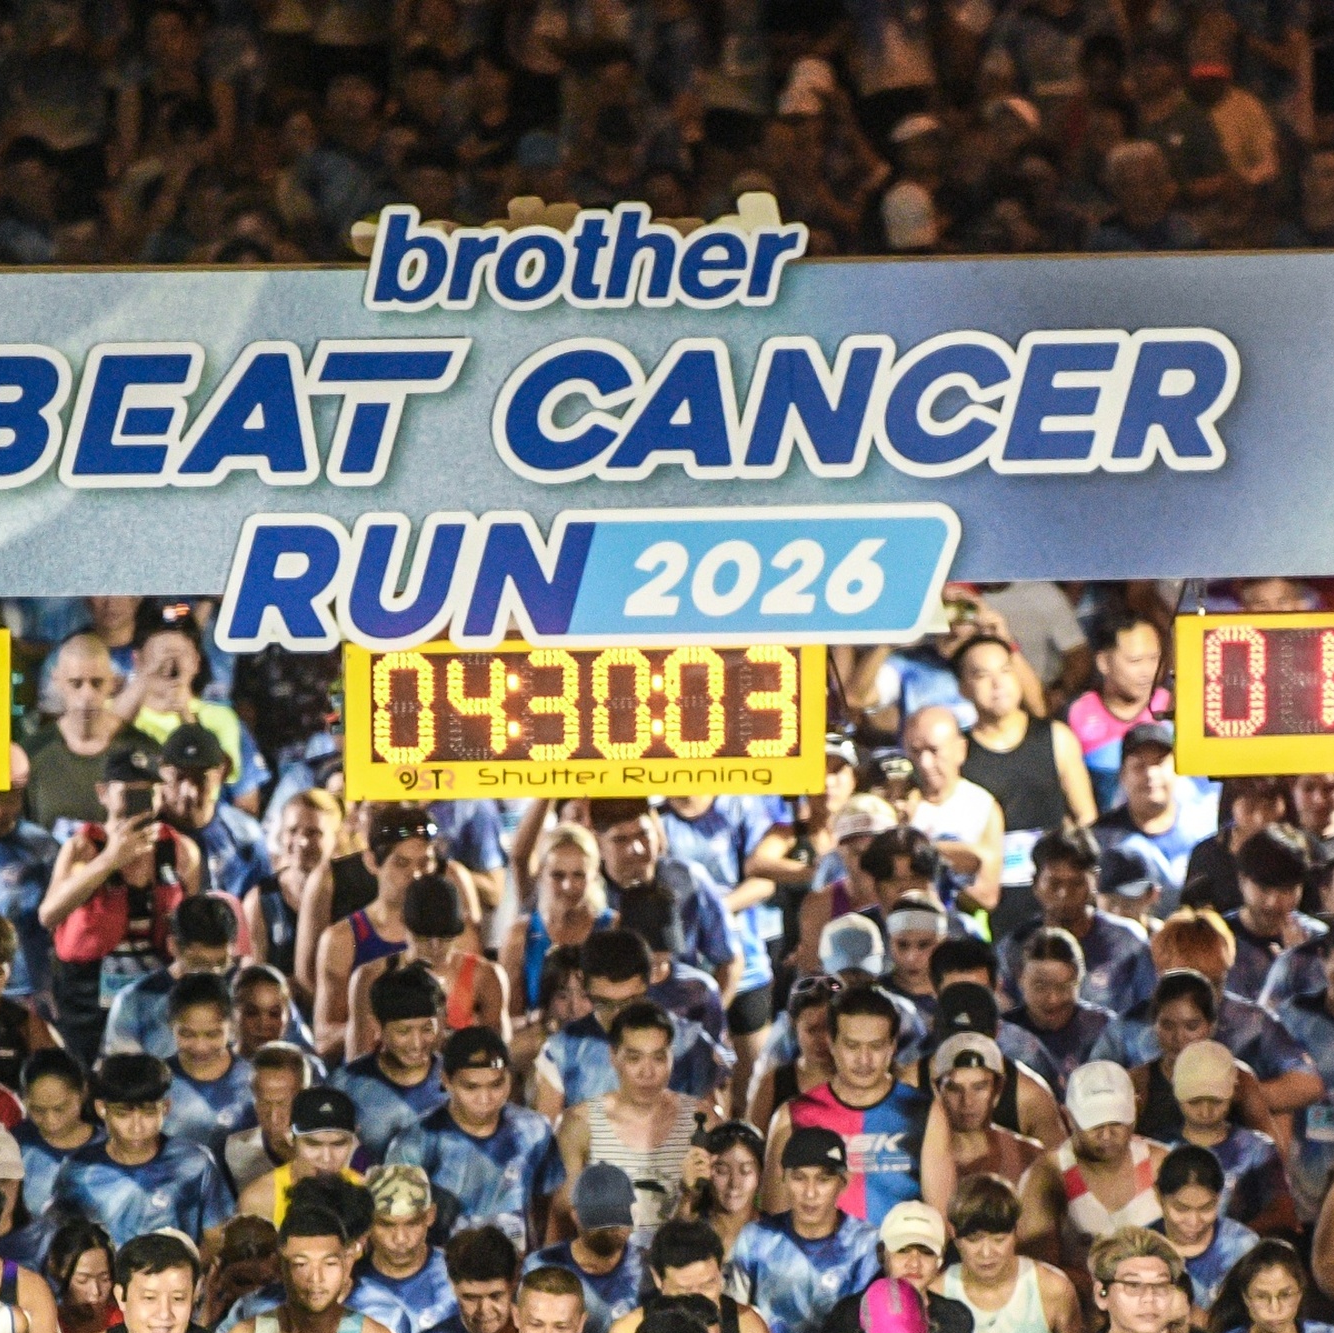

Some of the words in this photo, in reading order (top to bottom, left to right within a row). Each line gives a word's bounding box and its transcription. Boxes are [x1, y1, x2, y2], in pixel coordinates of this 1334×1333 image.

[373, 211, 789, 302] brother
[504, 340, 1228, 473] CANCER
[228, 519, 596, 641] RUN
[624, 538, 886, 617] 2026
[372, 645, 798, 766] 04:30:03
[477, 764, 611, 788] Shutter
[621, 762, 773, 788] Running
